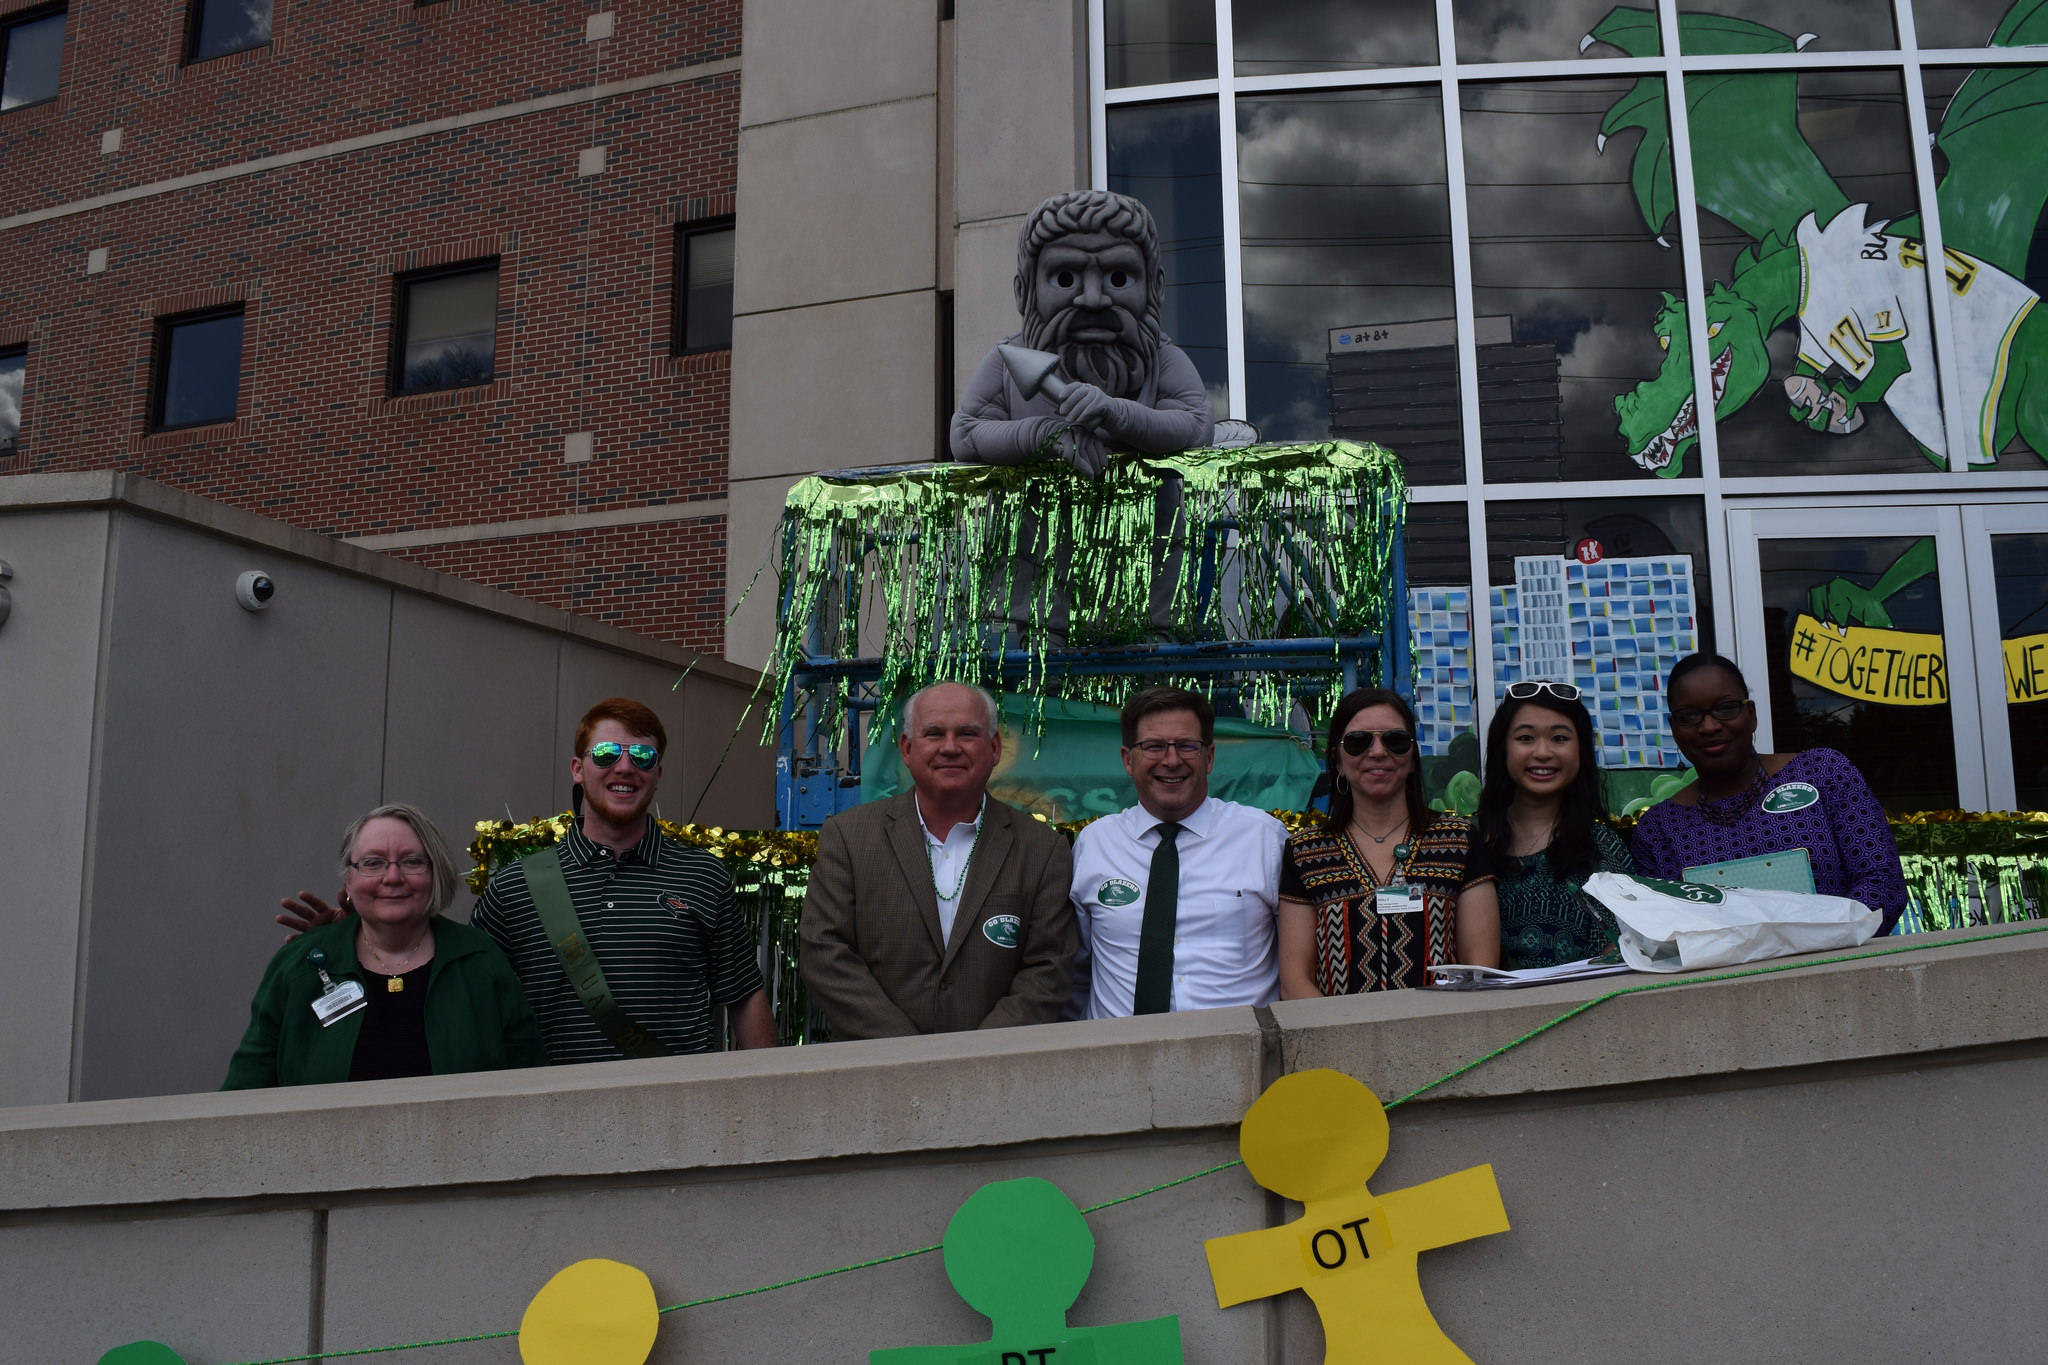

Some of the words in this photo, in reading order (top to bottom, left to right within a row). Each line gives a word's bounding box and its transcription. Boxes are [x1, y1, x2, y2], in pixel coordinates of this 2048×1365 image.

[1874, 310, 1891, 329] 17
[1829, 316, 1873, 371] 17
[1795, 628, 1945, 699] #TOGETHER
[2004, 644, 2048, 698] WE
[1766, 793, 1776, 803] GO
[1776, 784, 1813, 793] BLAZERS
[1100, 882, 1108, 891] GO
[1109, 880, 1139, 893] BLAZERS
[988, 919, 998, 928] GO
[1312, 1217, 1370, 1269] OT
